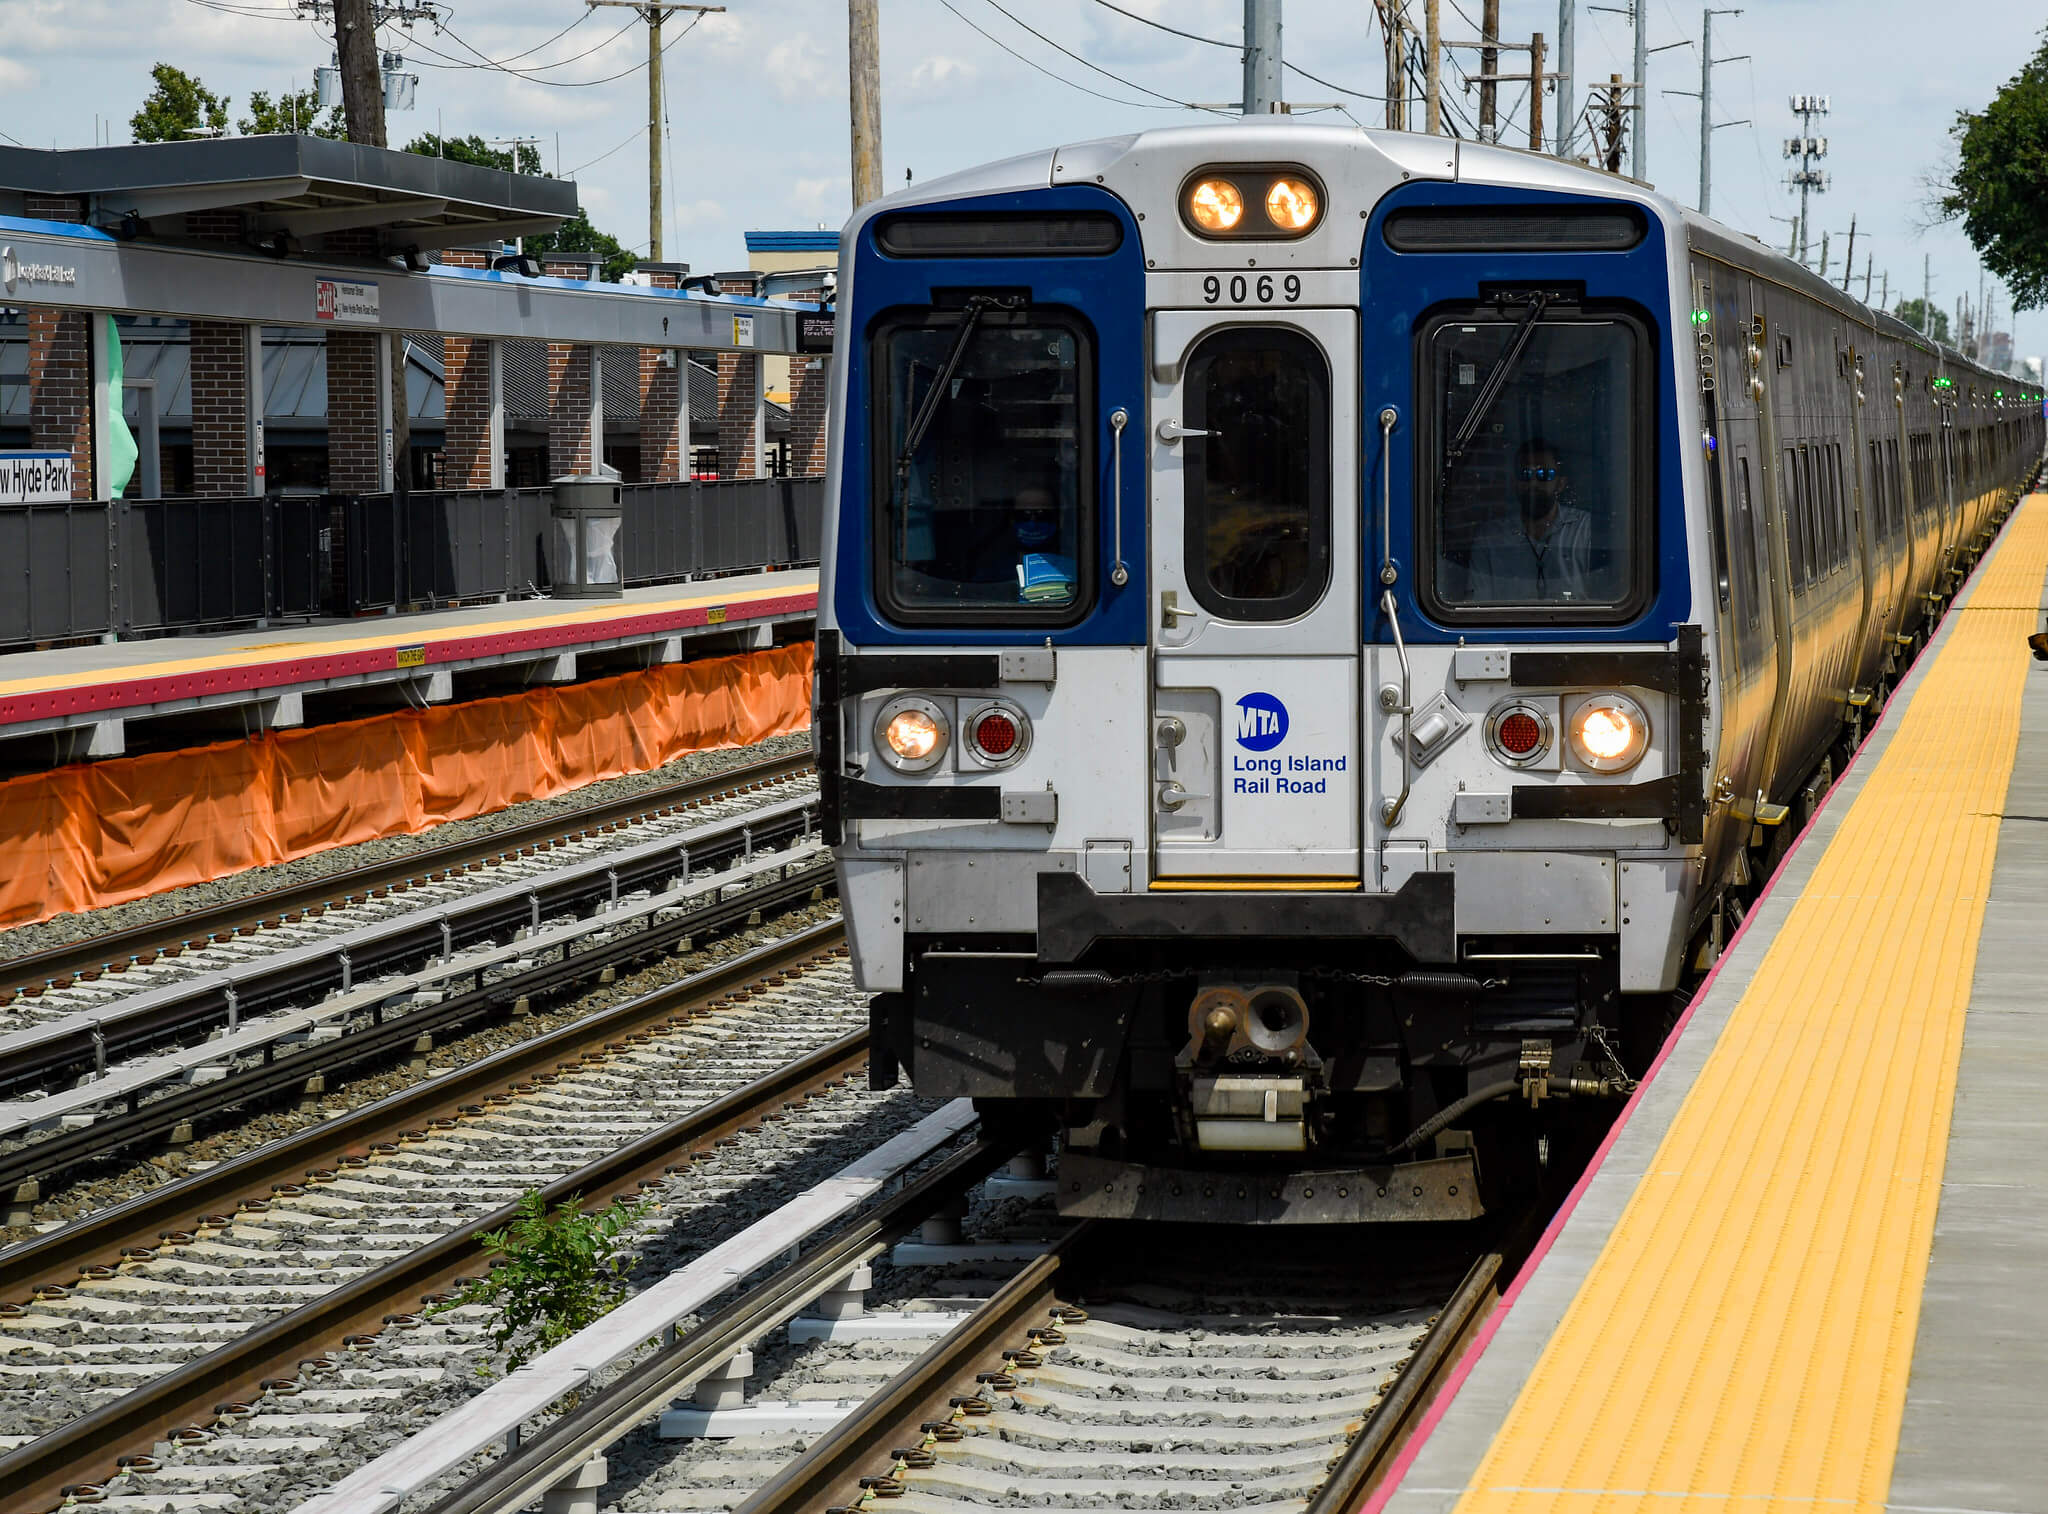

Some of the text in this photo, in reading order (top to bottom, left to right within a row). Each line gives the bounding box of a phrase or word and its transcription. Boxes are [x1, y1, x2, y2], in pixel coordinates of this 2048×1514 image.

[317, 282, 335, 313] Exit
[1203, 274, 1301, 304] 9069
[13, 458, 42, 502] Hyde
[45, 458, 69, 492] Park
[1235, 704, 1280, 740] MTA
[1233, 755, 1346, 775] Long Island
[1233, 777, 1326, 794] Rail Road
